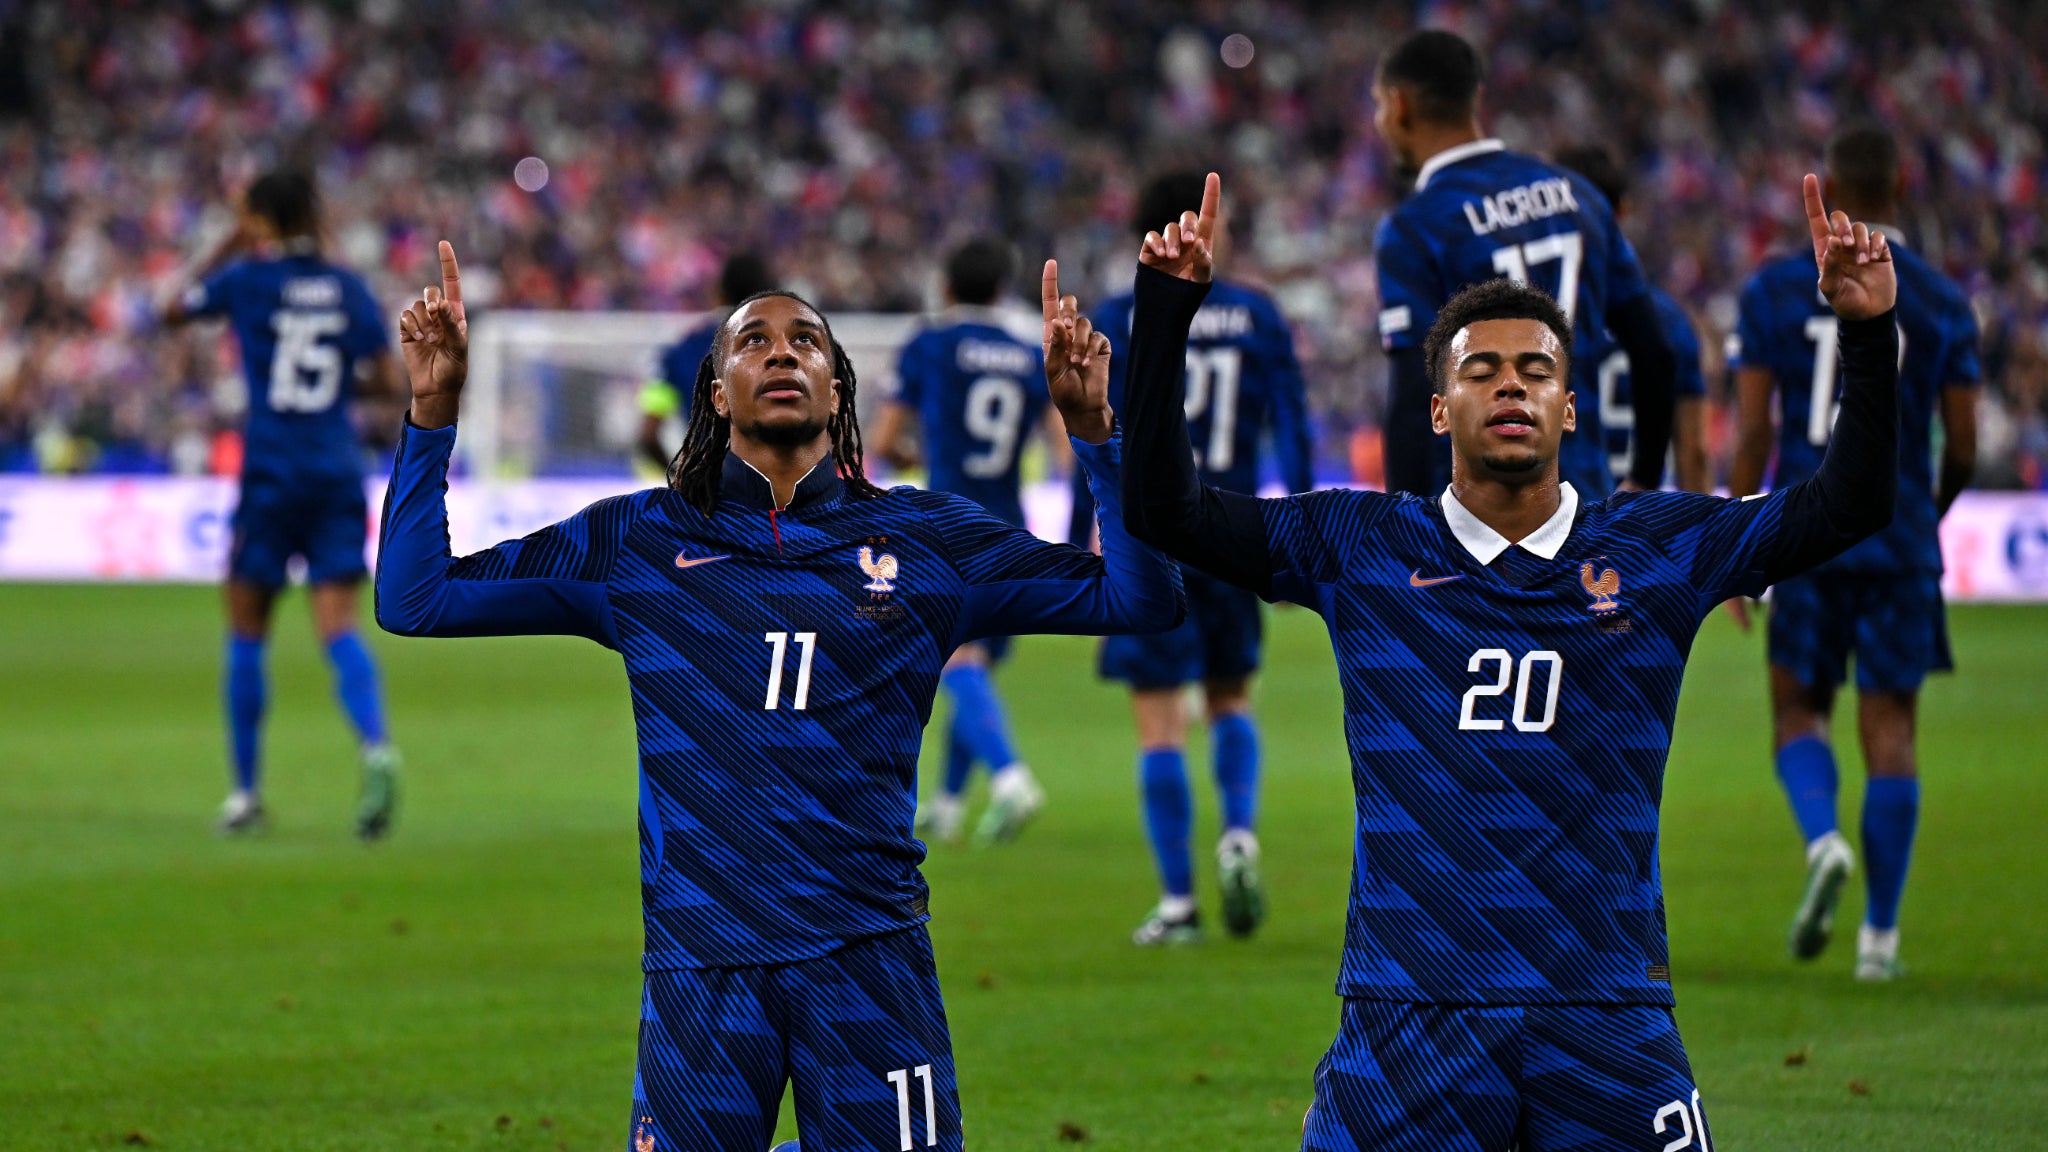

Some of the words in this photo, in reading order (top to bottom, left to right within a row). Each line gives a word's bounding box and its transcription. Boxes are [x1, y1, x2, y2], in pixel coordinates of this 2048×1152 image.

[1463, 177, 1579, 235] LACROIX
[268, 311, 348, 412] 15
[962, 376, 1025, 478] 9
[764, 632, 816, 710] 11
[1458, 649, 1562, 732] 20
[887, 1064, 937, 1151] 11
